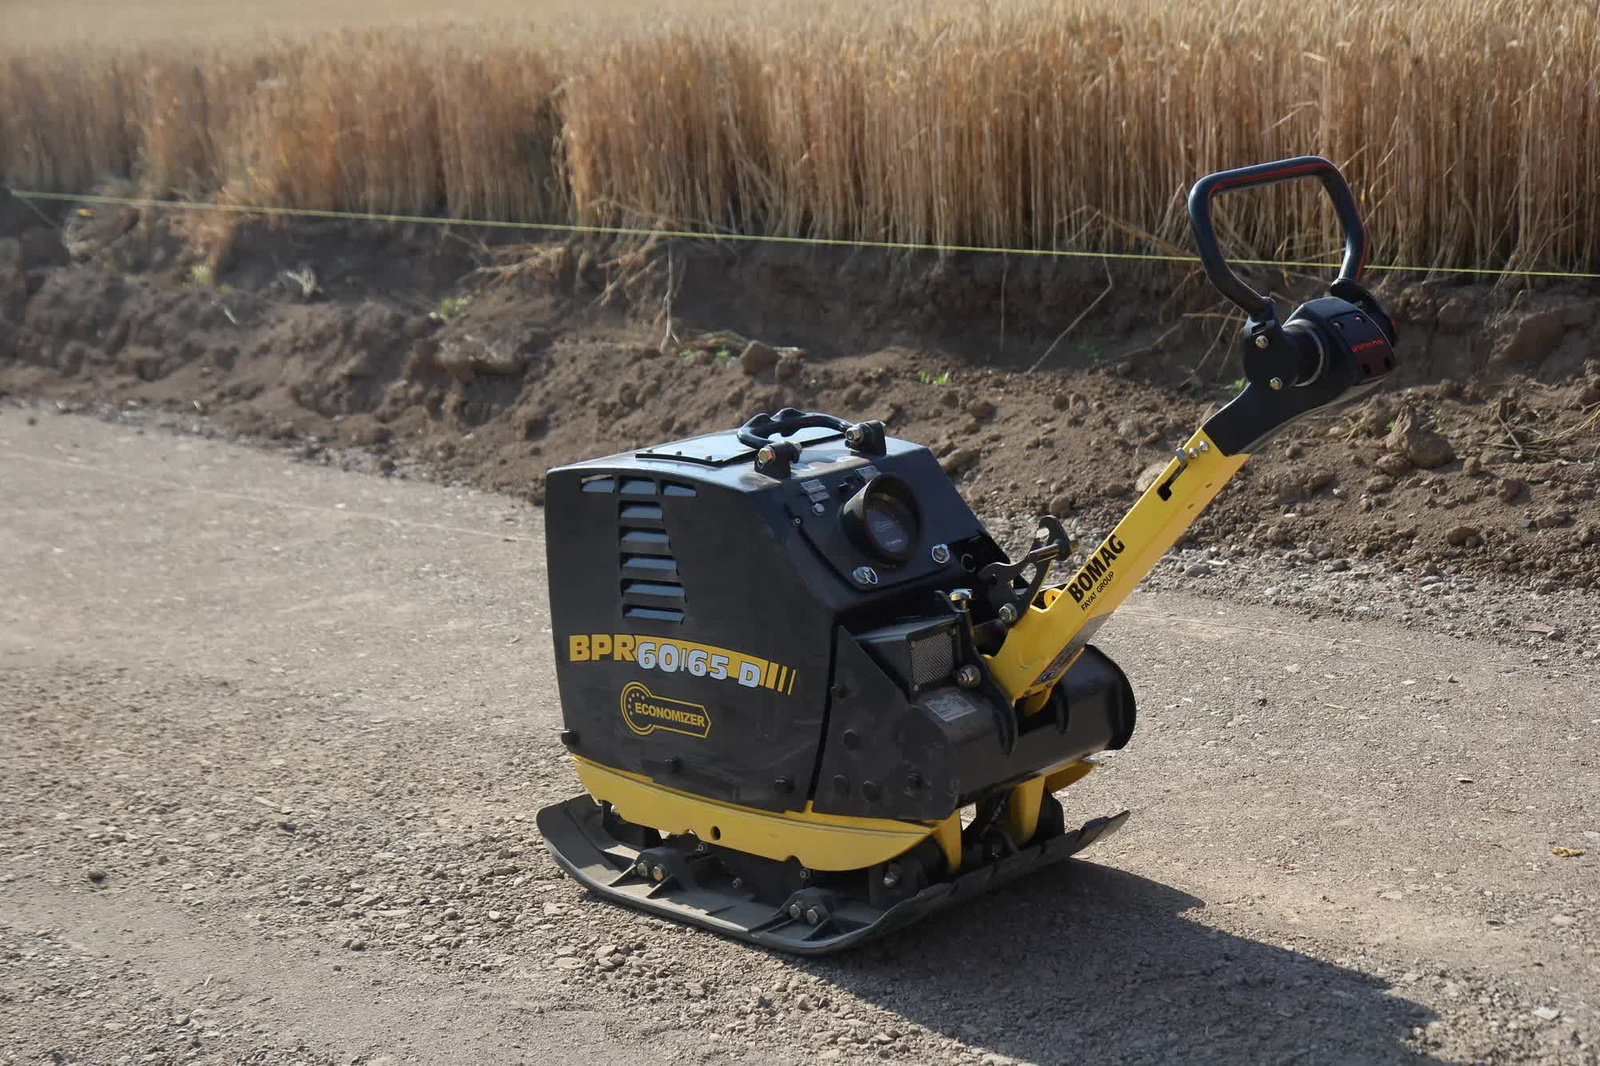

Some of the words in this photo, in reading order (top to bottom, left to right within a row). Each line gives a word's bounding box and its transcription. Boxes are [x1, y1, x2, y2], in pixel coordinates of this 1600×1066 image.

[1068, 534, 1125, 603] BOMAG
[1081, 592, 1098, 611] FAYAT
[1096, 571, 1115, 593] GROUP
[738, 661, 761, 688] D
[635, 702, 706, 727] ECONOMIZER
